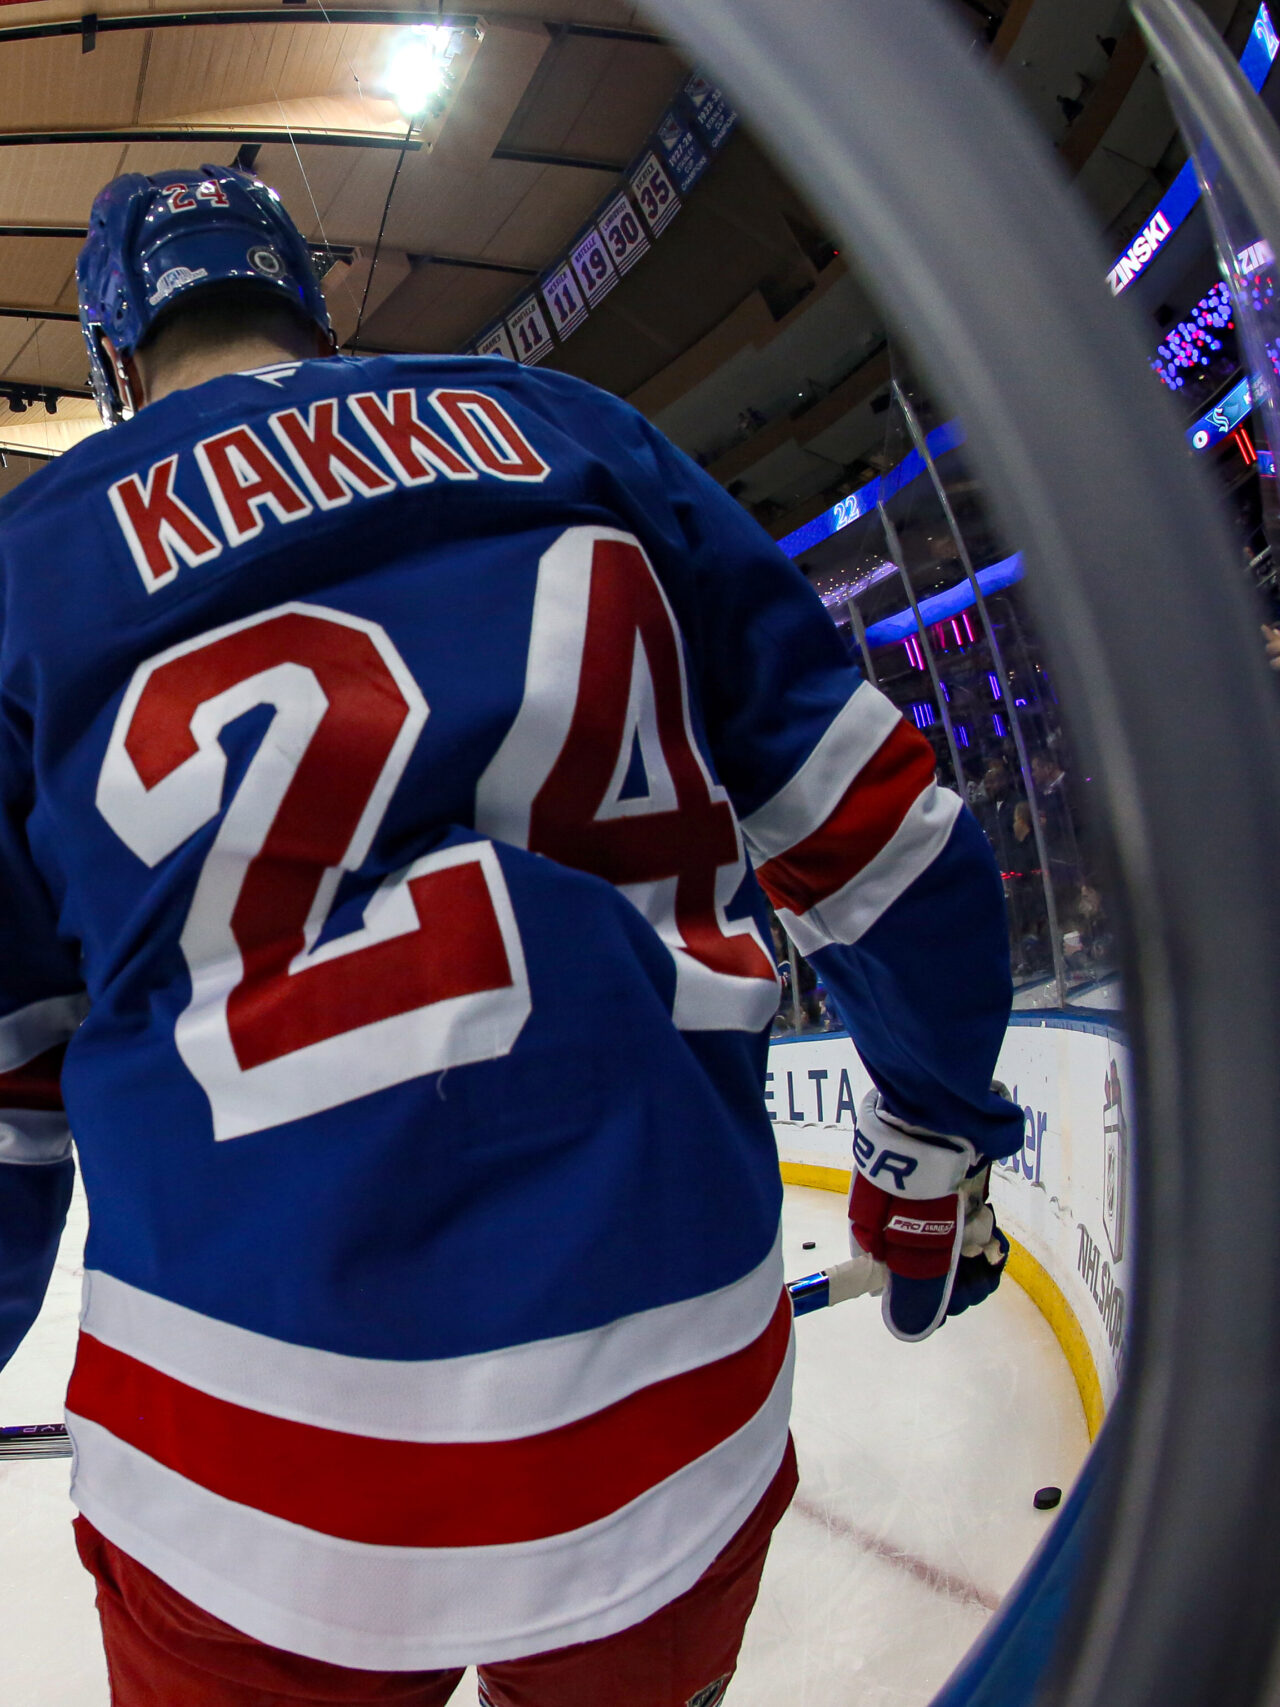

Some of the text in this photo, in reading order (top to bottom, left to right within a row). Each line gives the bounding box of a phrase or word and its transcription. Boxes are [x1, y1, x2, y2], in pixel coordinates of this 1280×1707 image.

[162, 179, 230, 213] 24
[641, 169, 670, 220] 35
[608, 212, 639, 258] 30
[581, 247, 607, 291] 19
[554, 283, 577, 324] 11
[519, 316, 543, 354] 11
[107, 389, 552, 595] KAKKO
[832, 494, 860, 531] 22
[94, 525, 782, 1143] 24
[892, 1218, 921, 1231] PRO
